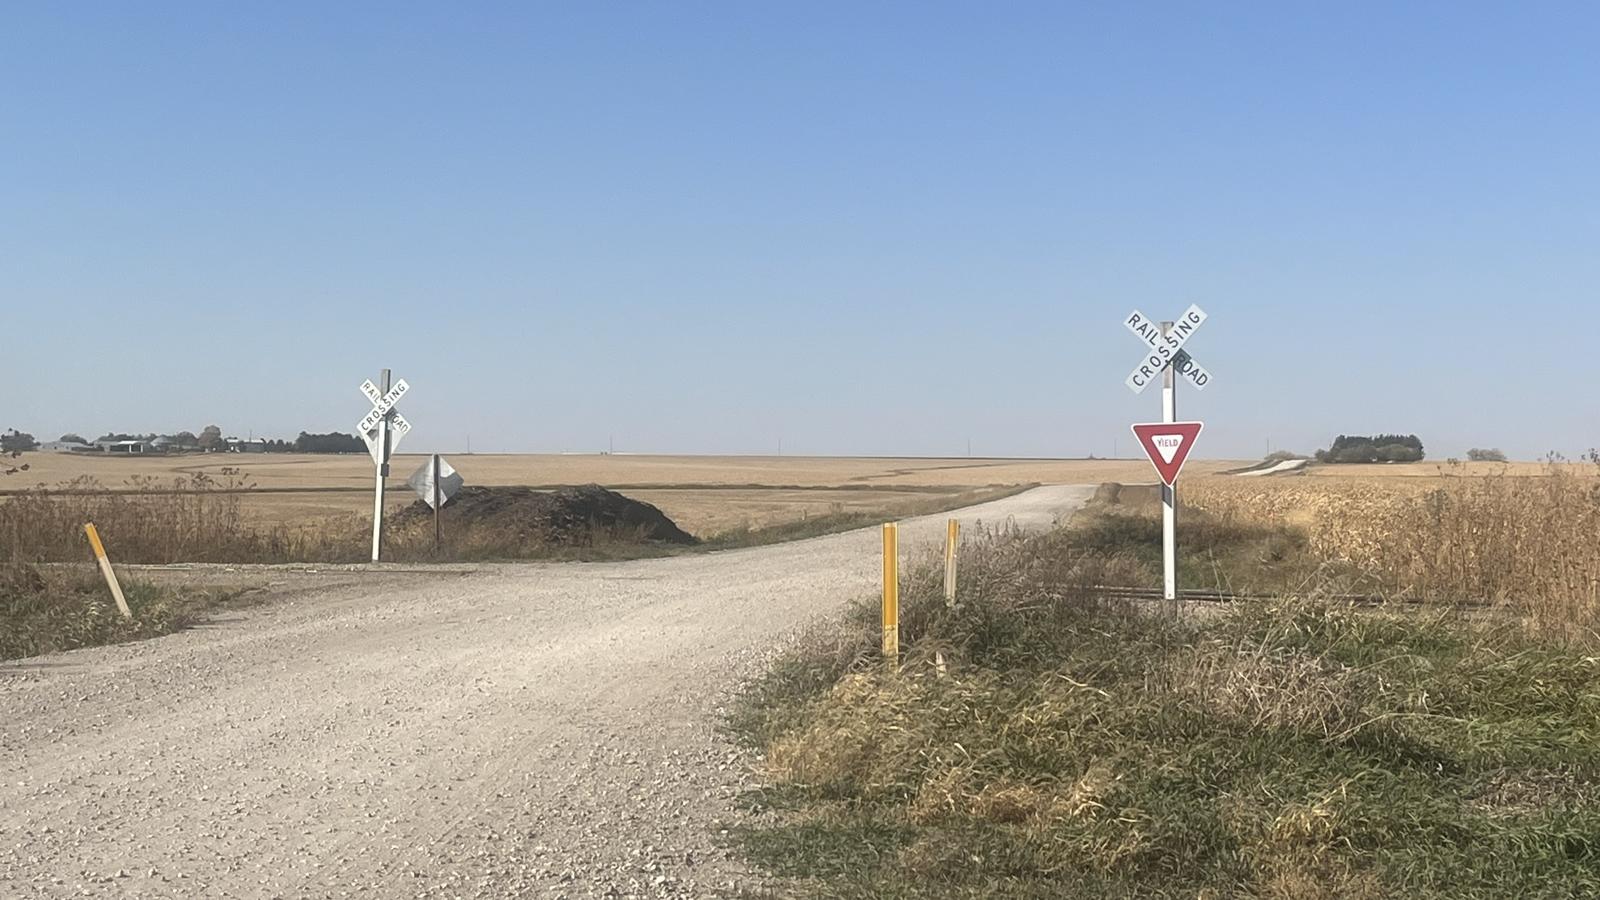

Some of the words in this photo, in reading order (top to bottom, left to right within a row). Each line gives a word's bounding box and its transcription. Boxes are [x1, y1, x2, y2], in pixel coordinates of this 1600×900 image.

[1128, 314, 1158, 345] RAIL
[1176, 354, 1208, 386] ROAD
[1132, 311, 1200, 387] CROSSING
[361, 383, 405, 430] CROSSING
[363, 382, 381, 403] RAIL
[1157, 438, 1178, 447] YIELD
